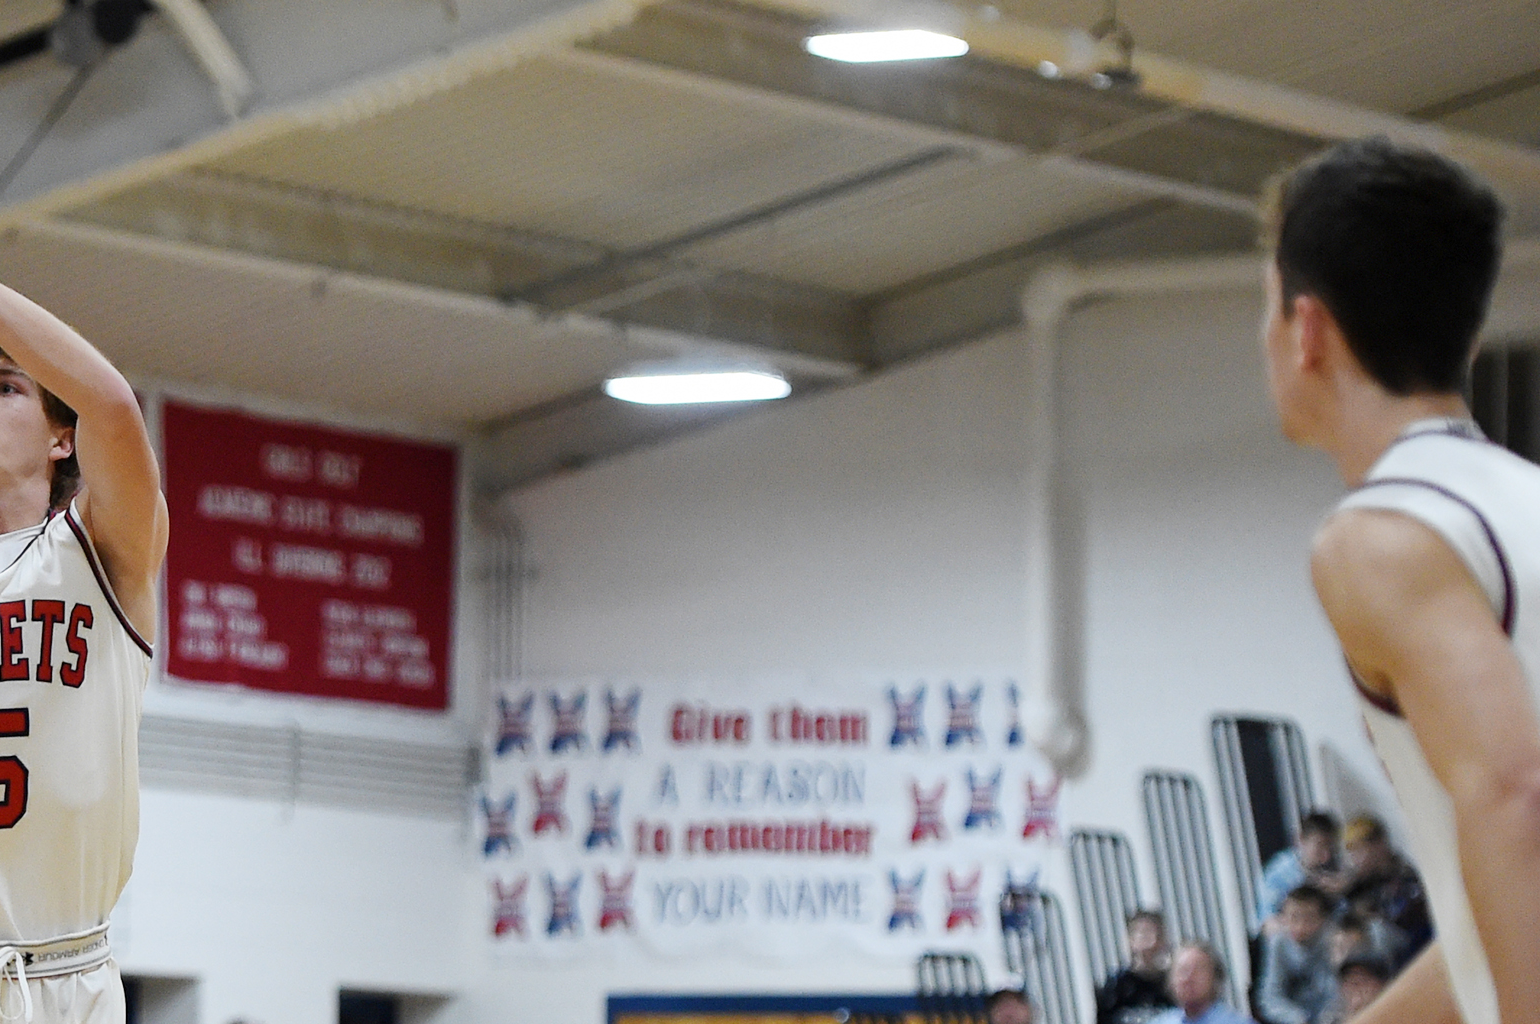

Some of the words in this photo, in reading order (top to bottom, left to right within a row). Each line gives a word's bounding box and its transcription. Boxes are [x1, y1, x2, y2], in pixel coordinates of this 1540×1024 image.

[672, 708, 751, 741] Give
[771, 706, 868, 741] them
[657, 763, 679, 803] A
[706, 761, 865, 803] REASON
[637, 820, 671, 853] to
[686, 818, 872, 854] remember
[654, 878, 751, 923] YOUR
[764, 877, 872, 921] NAME
[38, 948, 80, 962] ARMOUR
